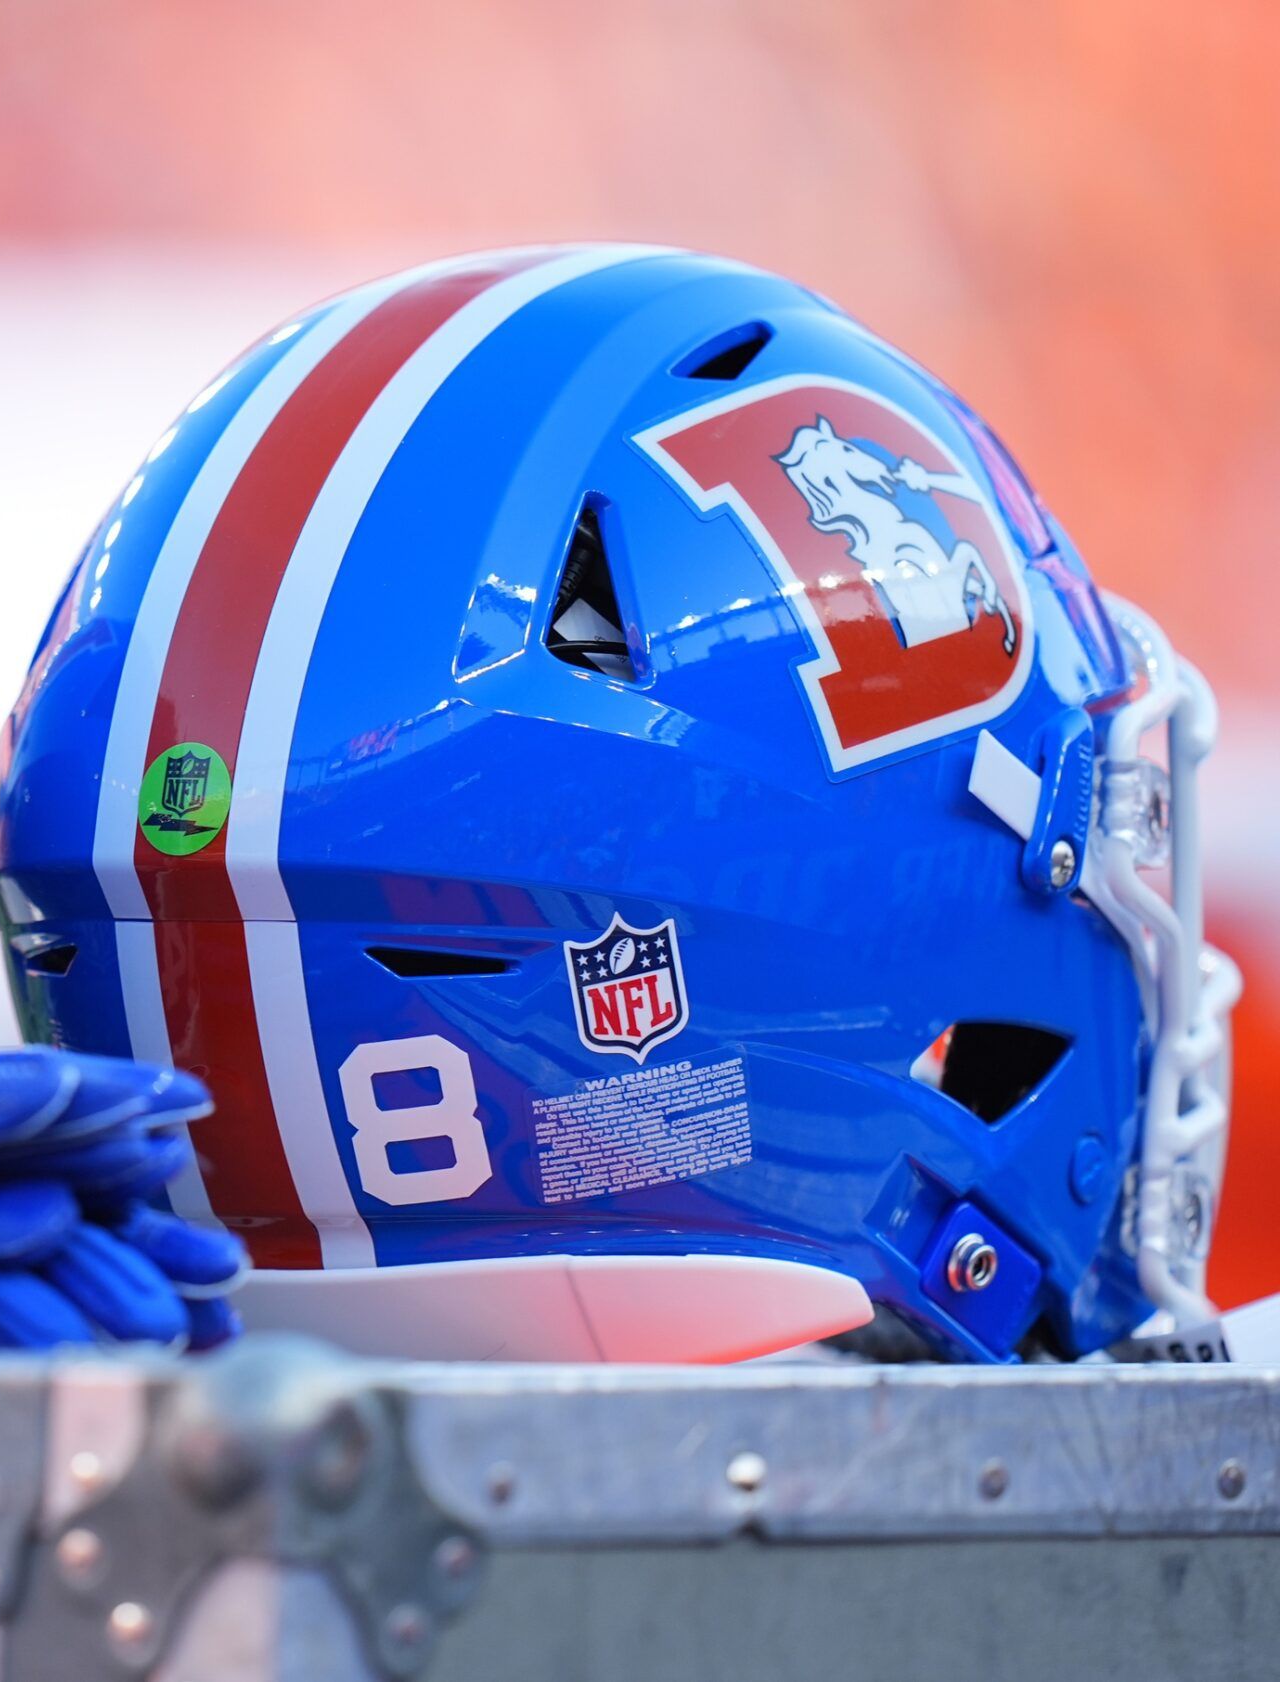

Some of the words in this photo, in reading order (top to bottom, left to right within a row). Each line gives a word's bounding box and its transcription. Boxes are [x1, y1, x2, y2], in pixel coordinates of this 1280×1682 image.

[167, 780, 201, 809] NFL
[587, 974, 673, 1037] NFL
[584, 1061, 692, 1092] WARNING
[339, 1034, 493, 1206] 8
